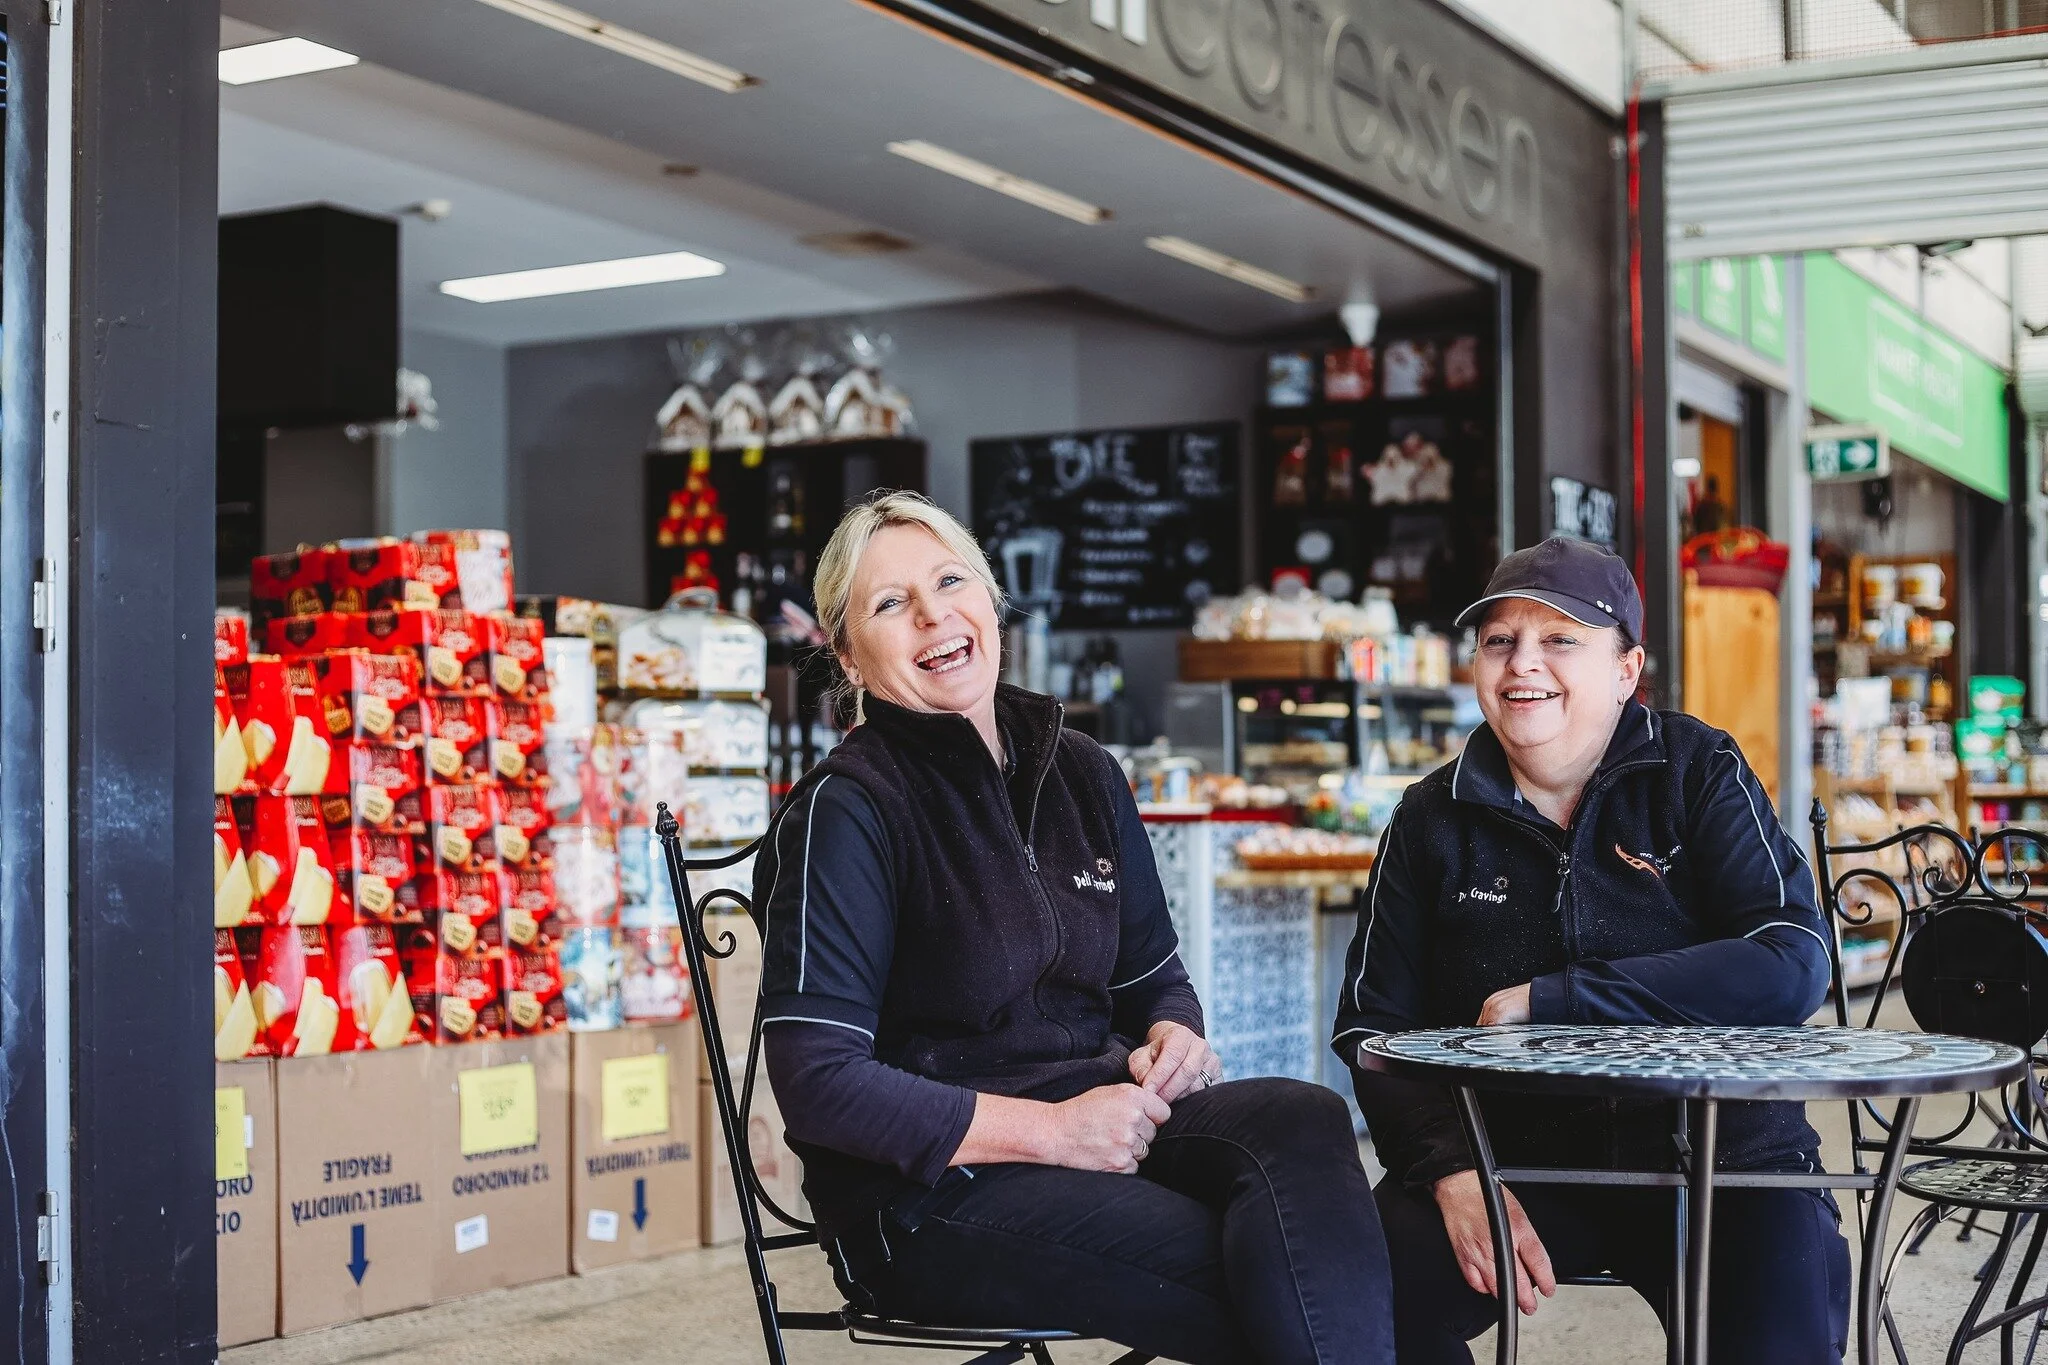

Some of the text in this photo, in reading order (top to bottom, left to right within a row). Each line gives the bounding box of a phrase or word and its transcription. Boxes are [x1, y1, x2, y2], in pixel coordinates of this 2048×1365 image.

[1470, 887, 1507, 904] Cravings
[322, 1152, 392, 1183] FRAGILE
[379, 1181, 424, 1208] TEME
